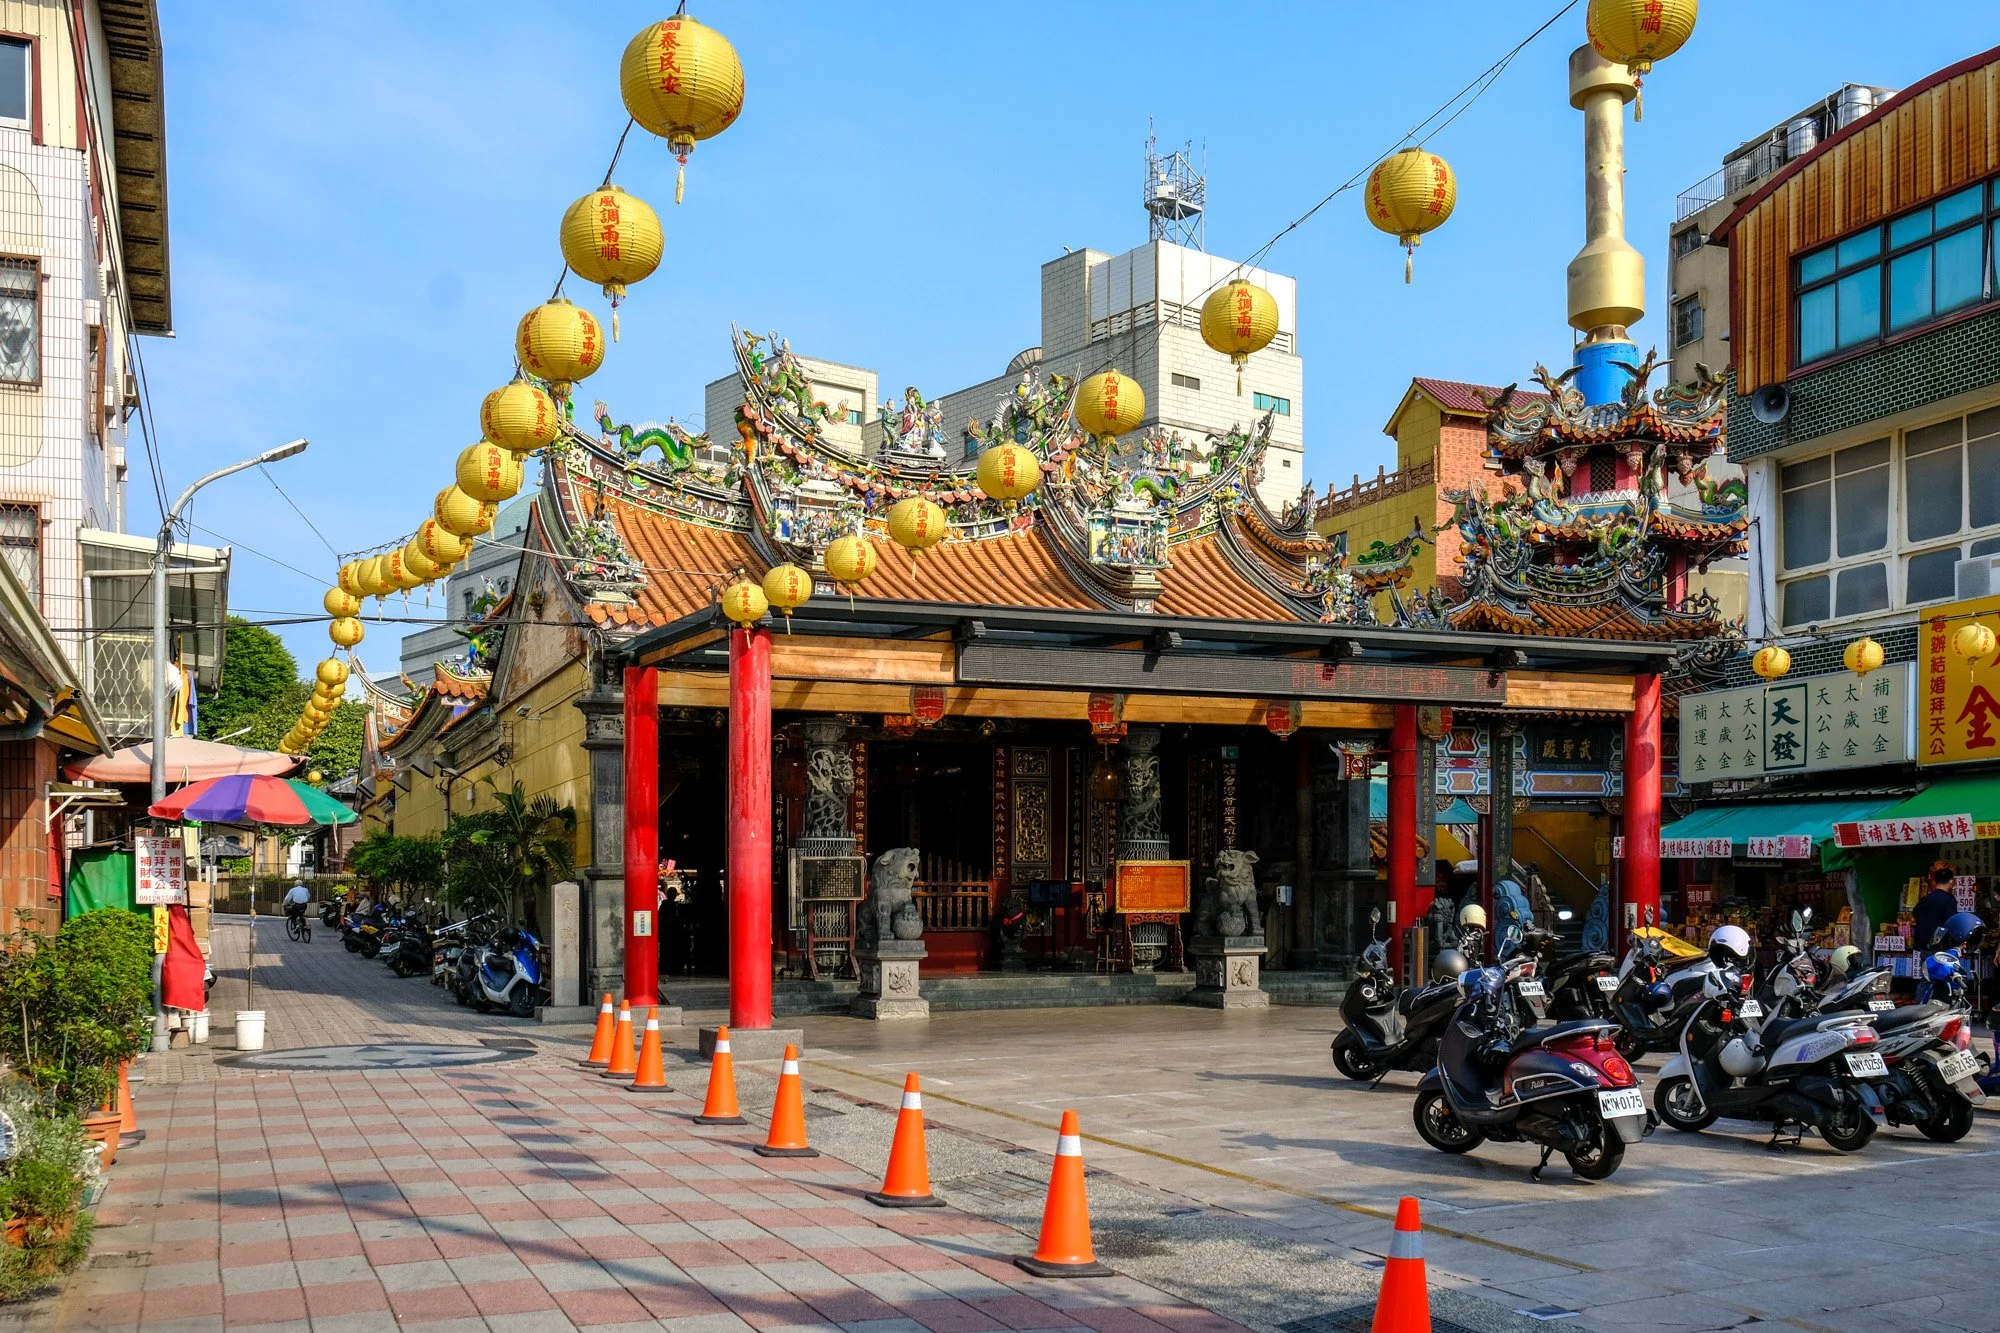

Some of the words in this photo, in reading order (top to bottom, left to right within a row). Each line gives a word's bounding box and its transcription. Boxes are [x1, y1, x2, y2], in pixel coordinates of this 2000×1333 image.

[657, 21, 681, 96] 國泰民安
[1430, 156, 1448, 217] 風調雨順
[599, 195, 620, 262] 風調雨順
[578, 310, 596, 367] 風調雨順
[1235, 288, 1252, 339] 風調雨順
[532, 390, 548, 439] 國泰民安
[1104, 372, 1119, 422] 風調雨順
[486, 447, 501, 491] 風調雨順
[1002, 448, 1015, 489] 風調雨順
[916, 501, 928, 539] 風調雨順
[788, 569, 799, 602] 風調雨順
[855, 541, 867, 575] 風調雨順
[1930, 614, 1947, 756] 專辦結婚拜天公
[1693, 704, 1708, 772] 補運金
[1718, 701, 1733, 769] 太歲金
[1742, 697, 1757, 768] 天公金
[1770, 696, 1802, 762] 天發
[1815, 687, 1832, 761] 天公金
[1843, 684, 1860, 758] 太歲金
[1872, 677, 1890, 753] 補運金
[1868, 822, 1916, 843] 補運金
[1921, 817, 1970, 840] 補財庫
[1959, 899, 1974, 907] 500
